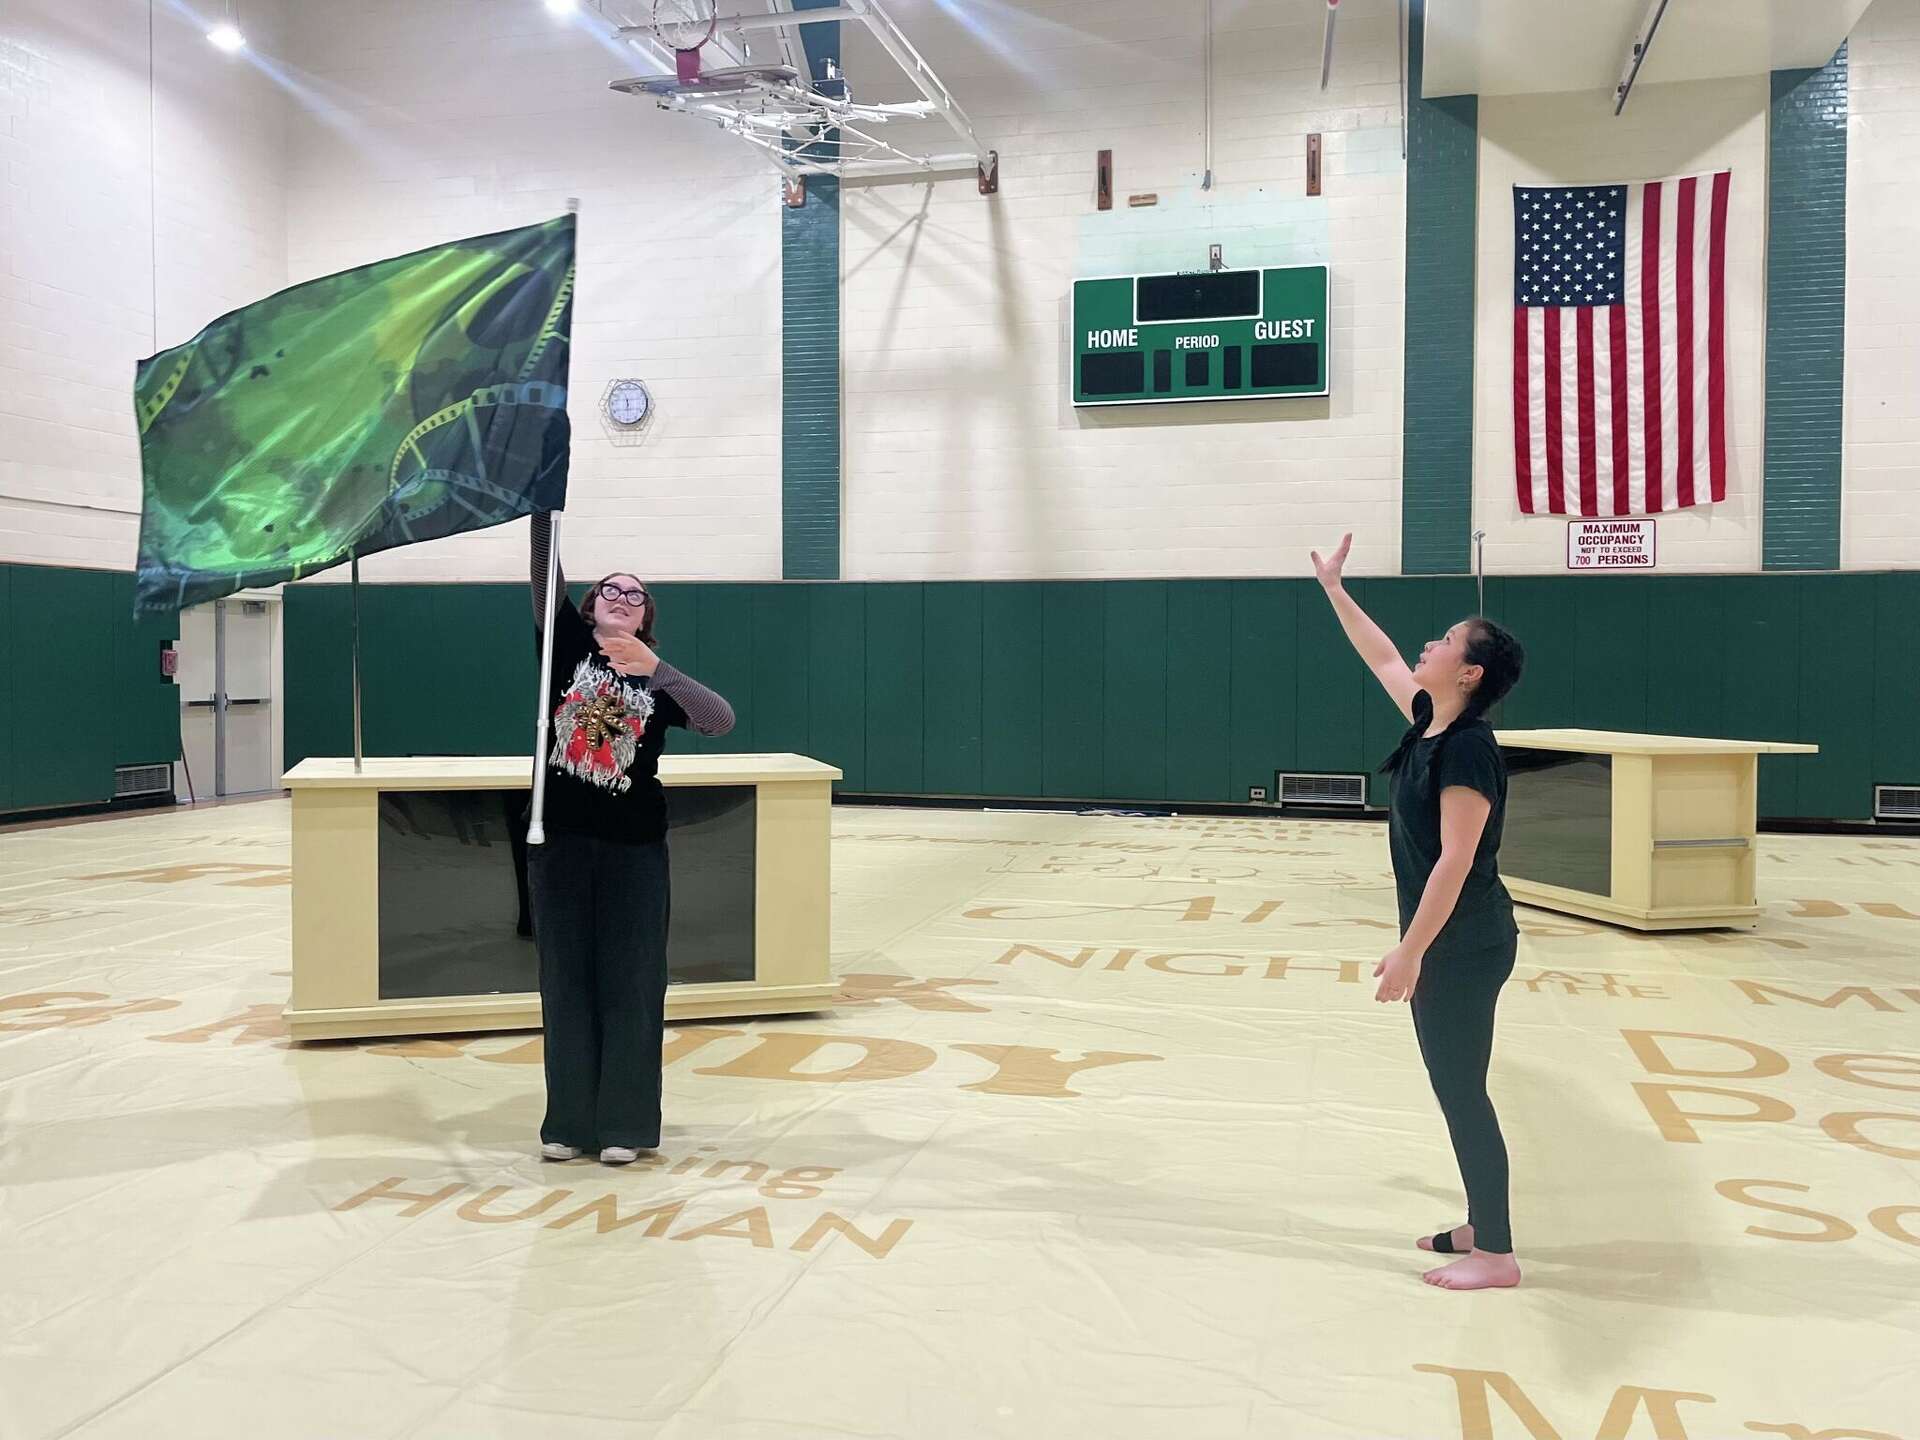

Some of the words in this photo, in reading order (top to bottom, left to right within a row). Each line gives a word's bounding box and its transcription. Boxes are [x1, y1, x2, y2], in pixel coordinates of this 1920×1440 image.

[1087, 328, 1139, 349] HOME
[1254, 319, 1315, 340] GUEST
[1175, 335, 1220, 350] PERIOD
[1583, 523, 1640, 534] MAXIMUM
[1578, 534, 1645, 545] OCCUPANCY
[1575, 555, 1591, 565] 700
[1597, 554, 1649, 565] PERSONS
[992, 943, 1377, 984] NIGH
[332, 1176, 916, 1260] HUMAN
